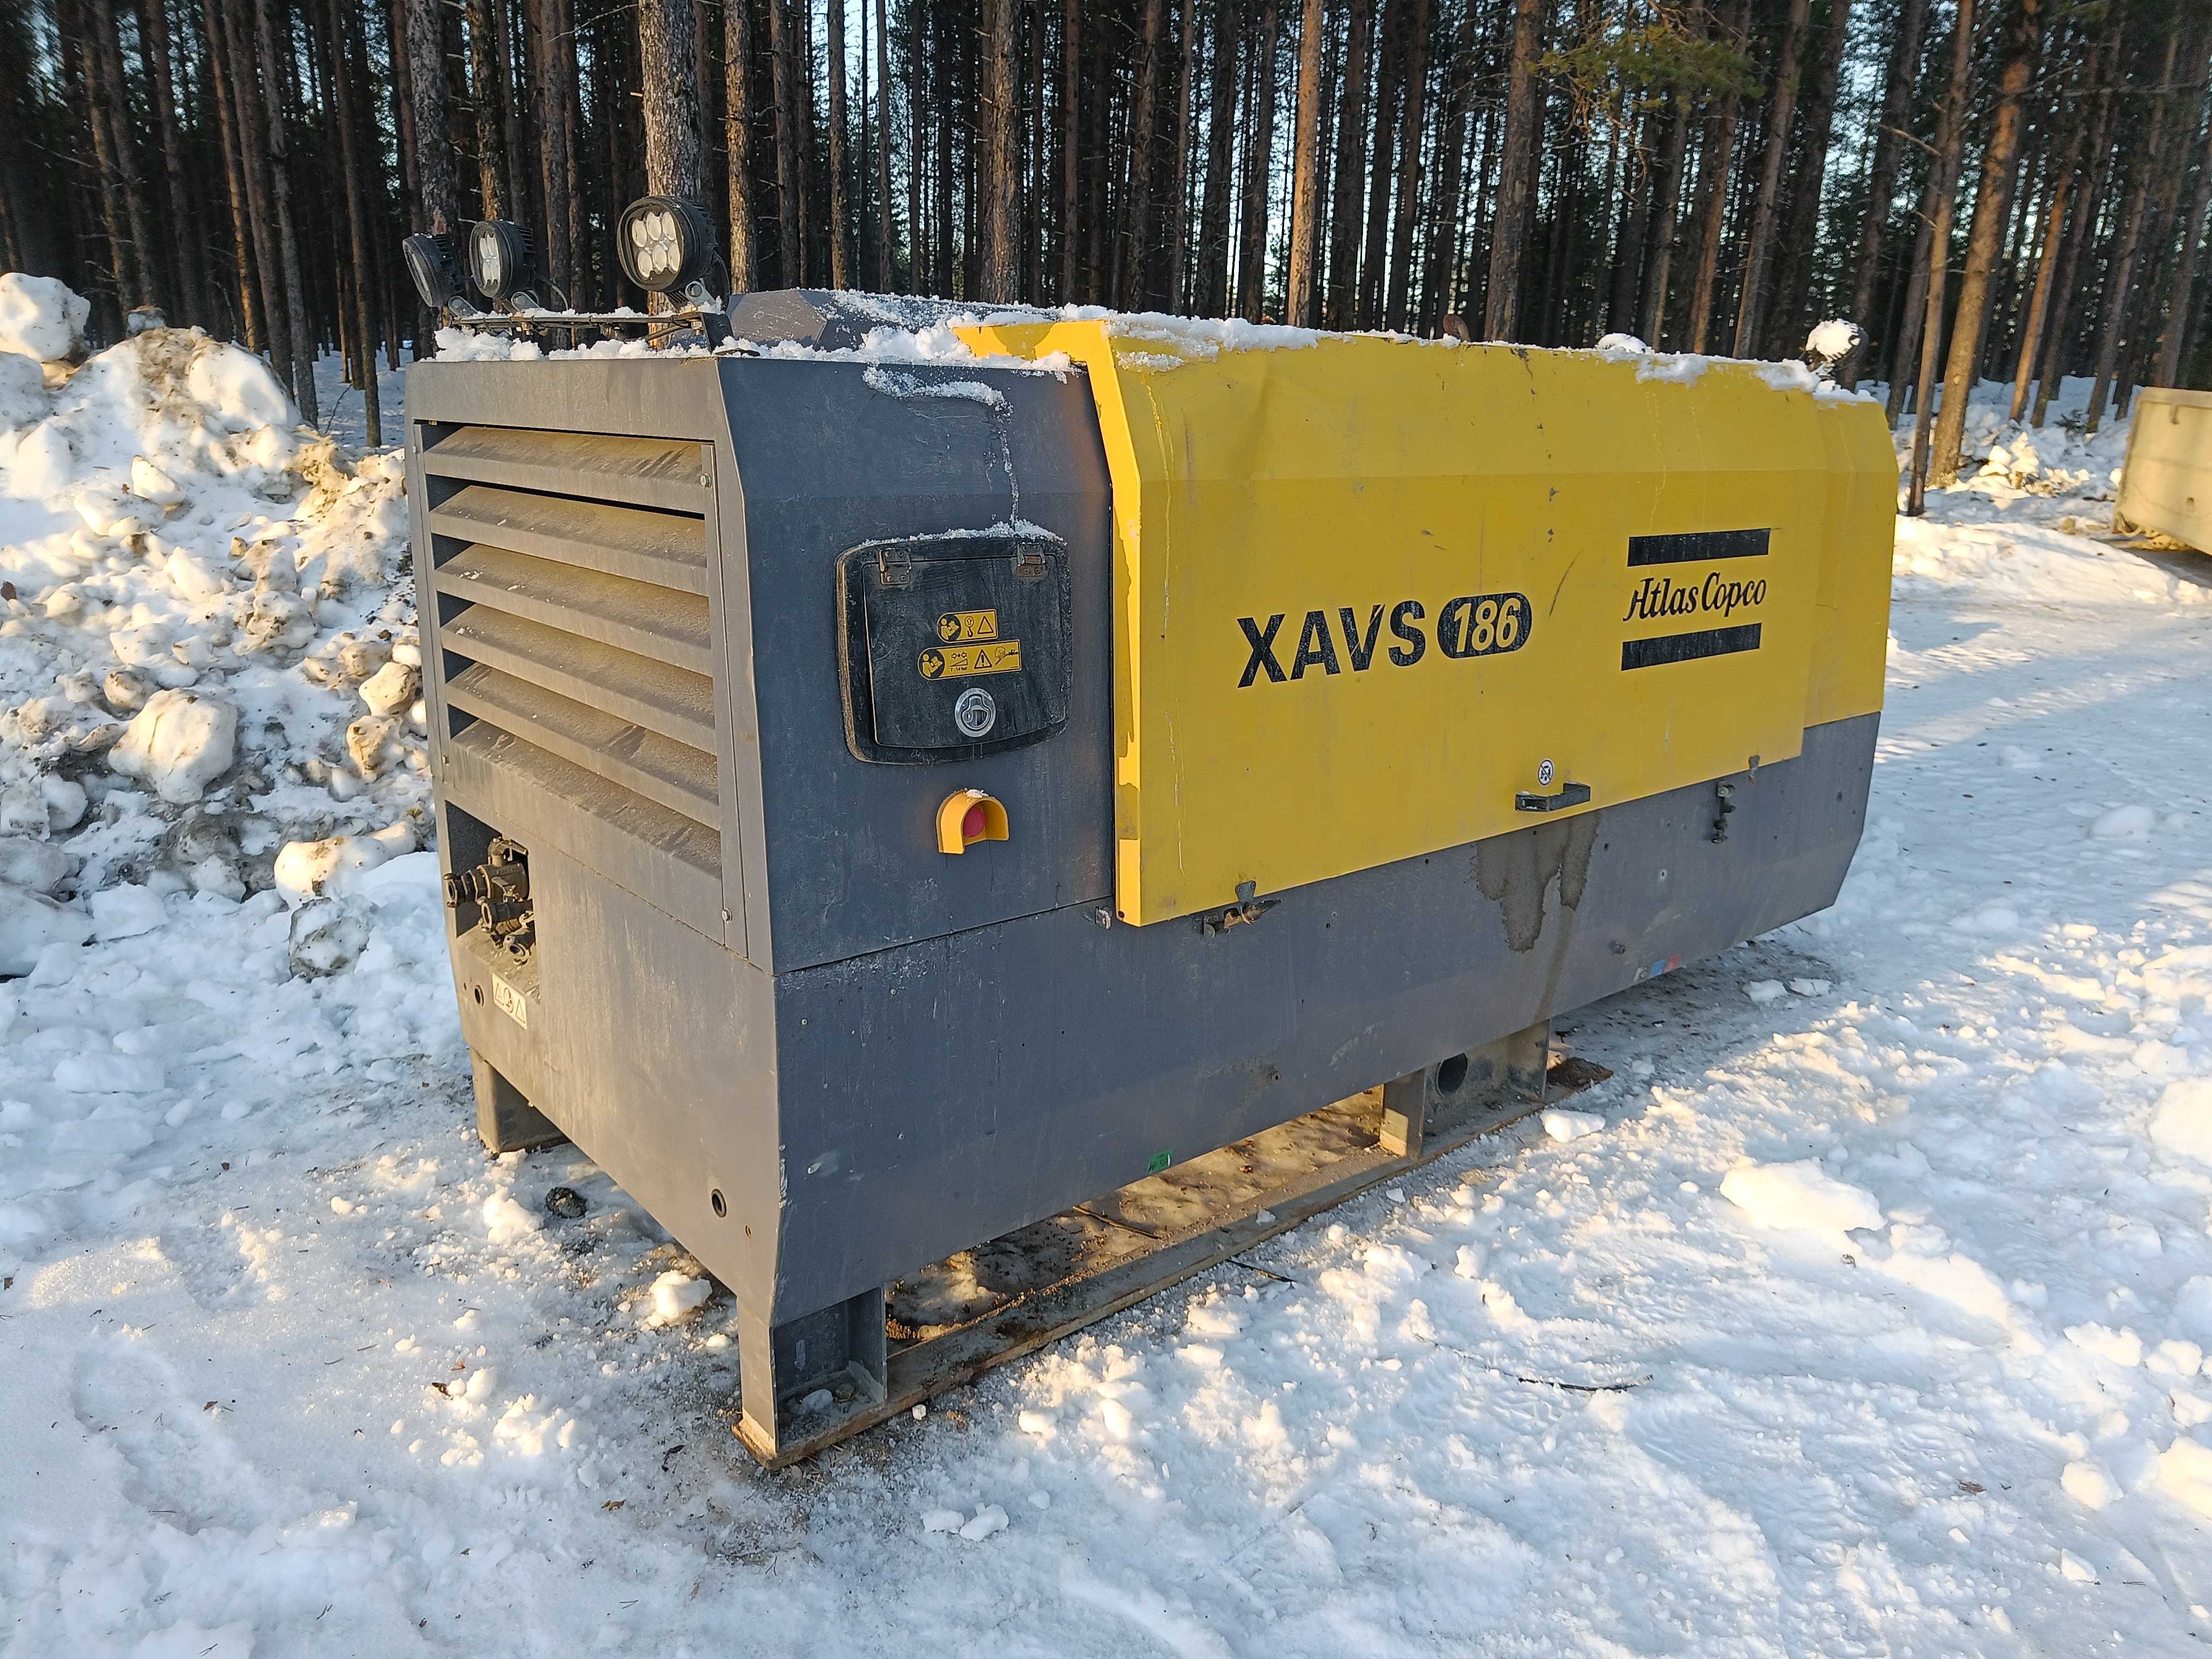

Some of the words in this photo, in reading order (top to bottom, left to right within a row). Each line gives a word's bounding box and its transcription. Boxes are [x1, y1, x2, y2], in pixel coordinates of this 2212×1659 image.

[1622, 577, 1699, 622] Atlas
[1702, 572, 1767, 618] Copco
[1237, 600, 1426, 689] XAVS
[1453, 597, 1521, 653] 186
